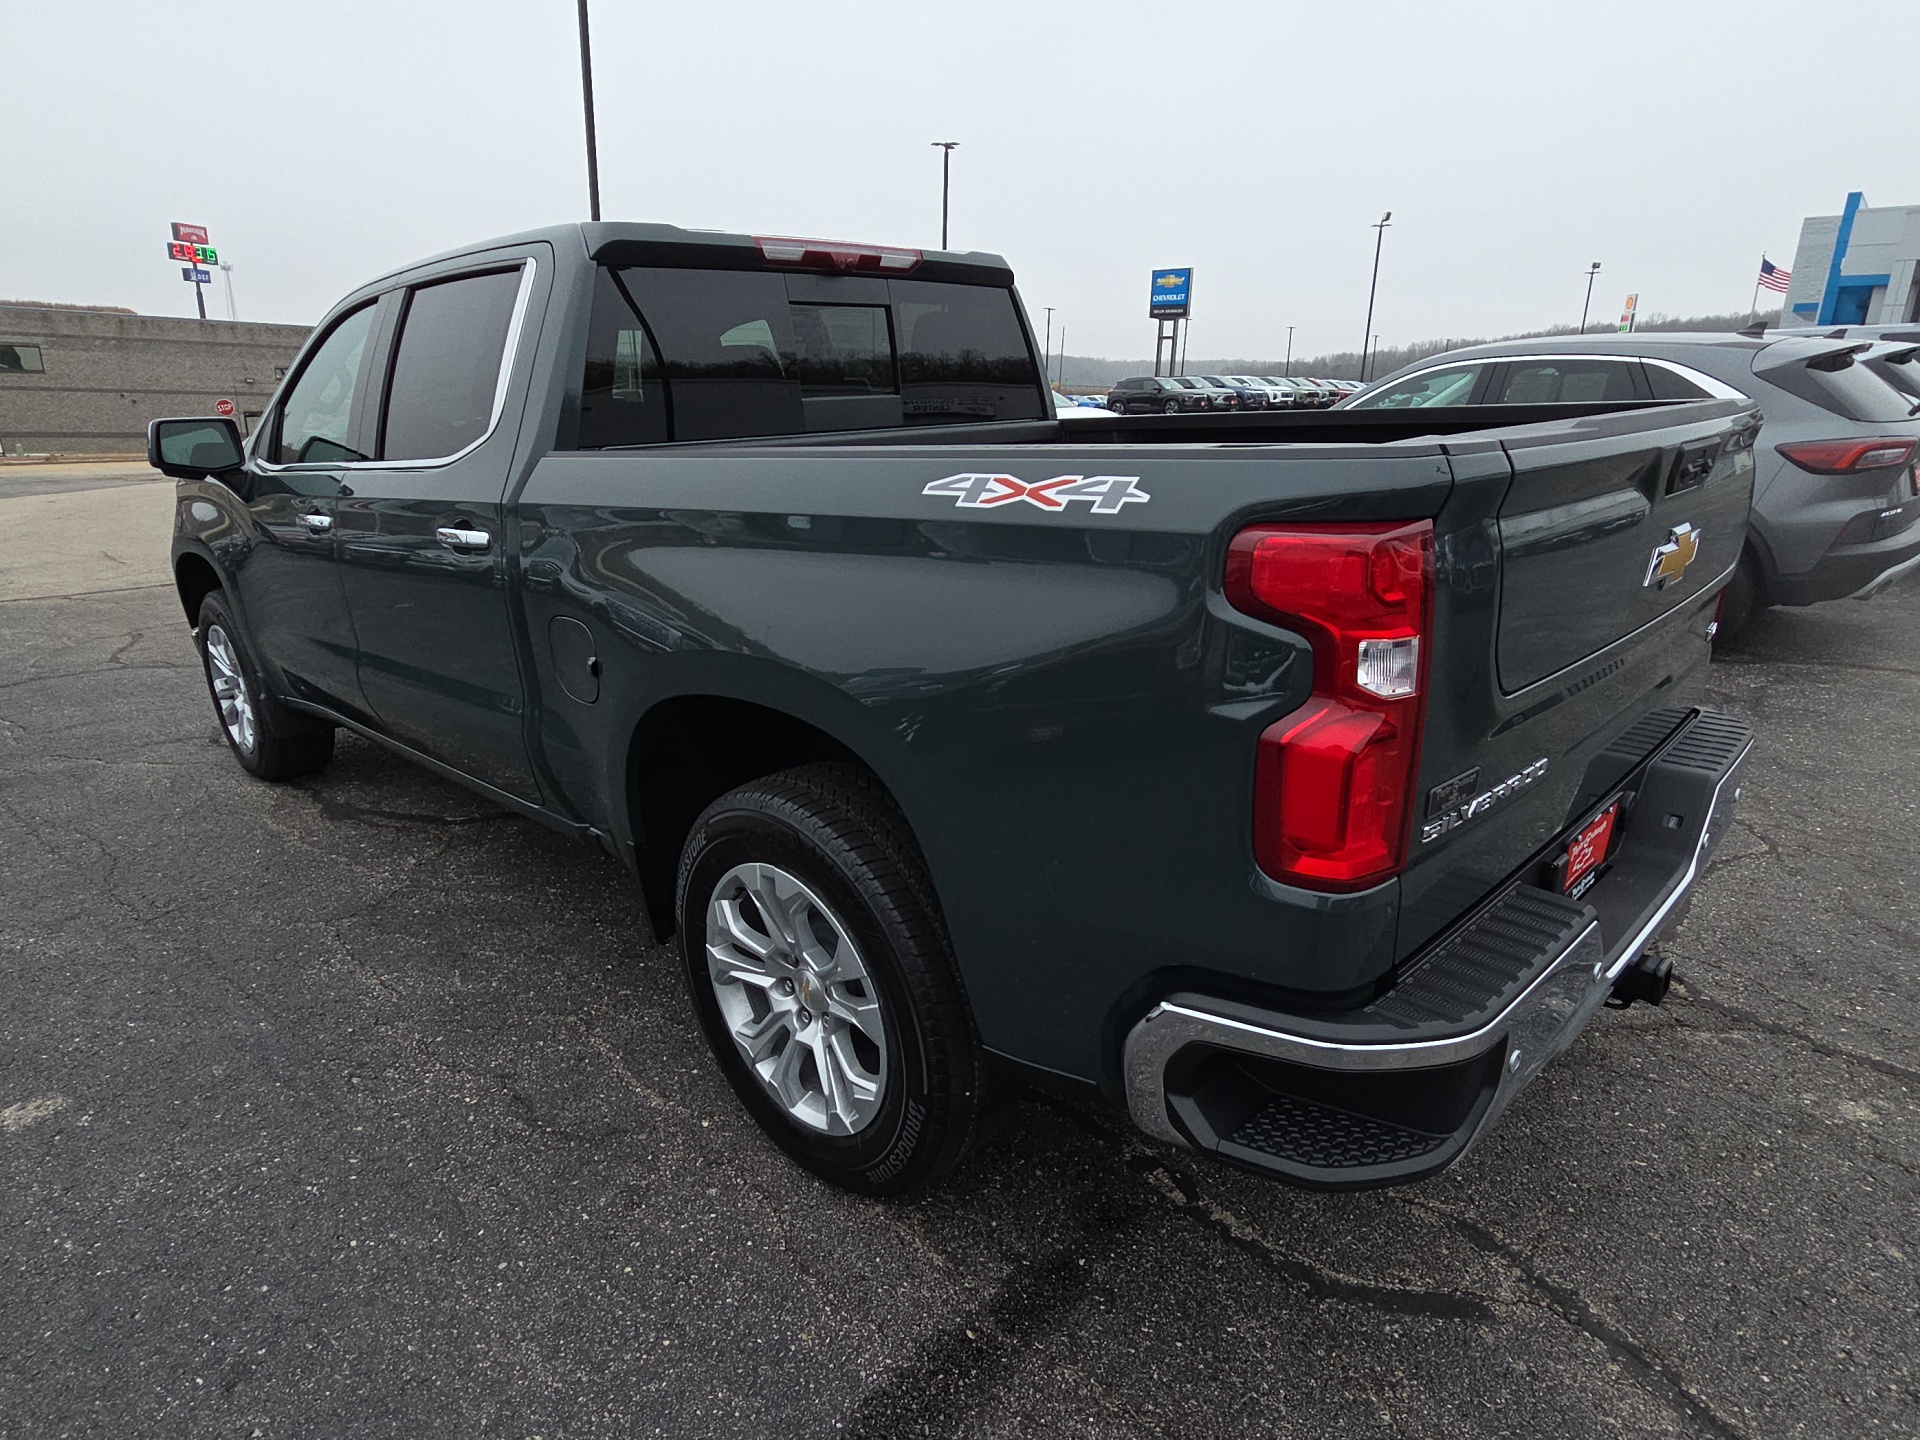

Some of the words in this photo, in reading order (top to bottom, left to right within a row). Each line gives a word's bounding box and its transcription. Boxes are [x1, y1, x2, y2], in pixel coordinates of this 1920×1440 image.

[217, 404, 232, 412] STOP
[1420, 757, 1549, 844] SILVERADO
[865, 1097, 926, 1184] BRIDGESTONE
